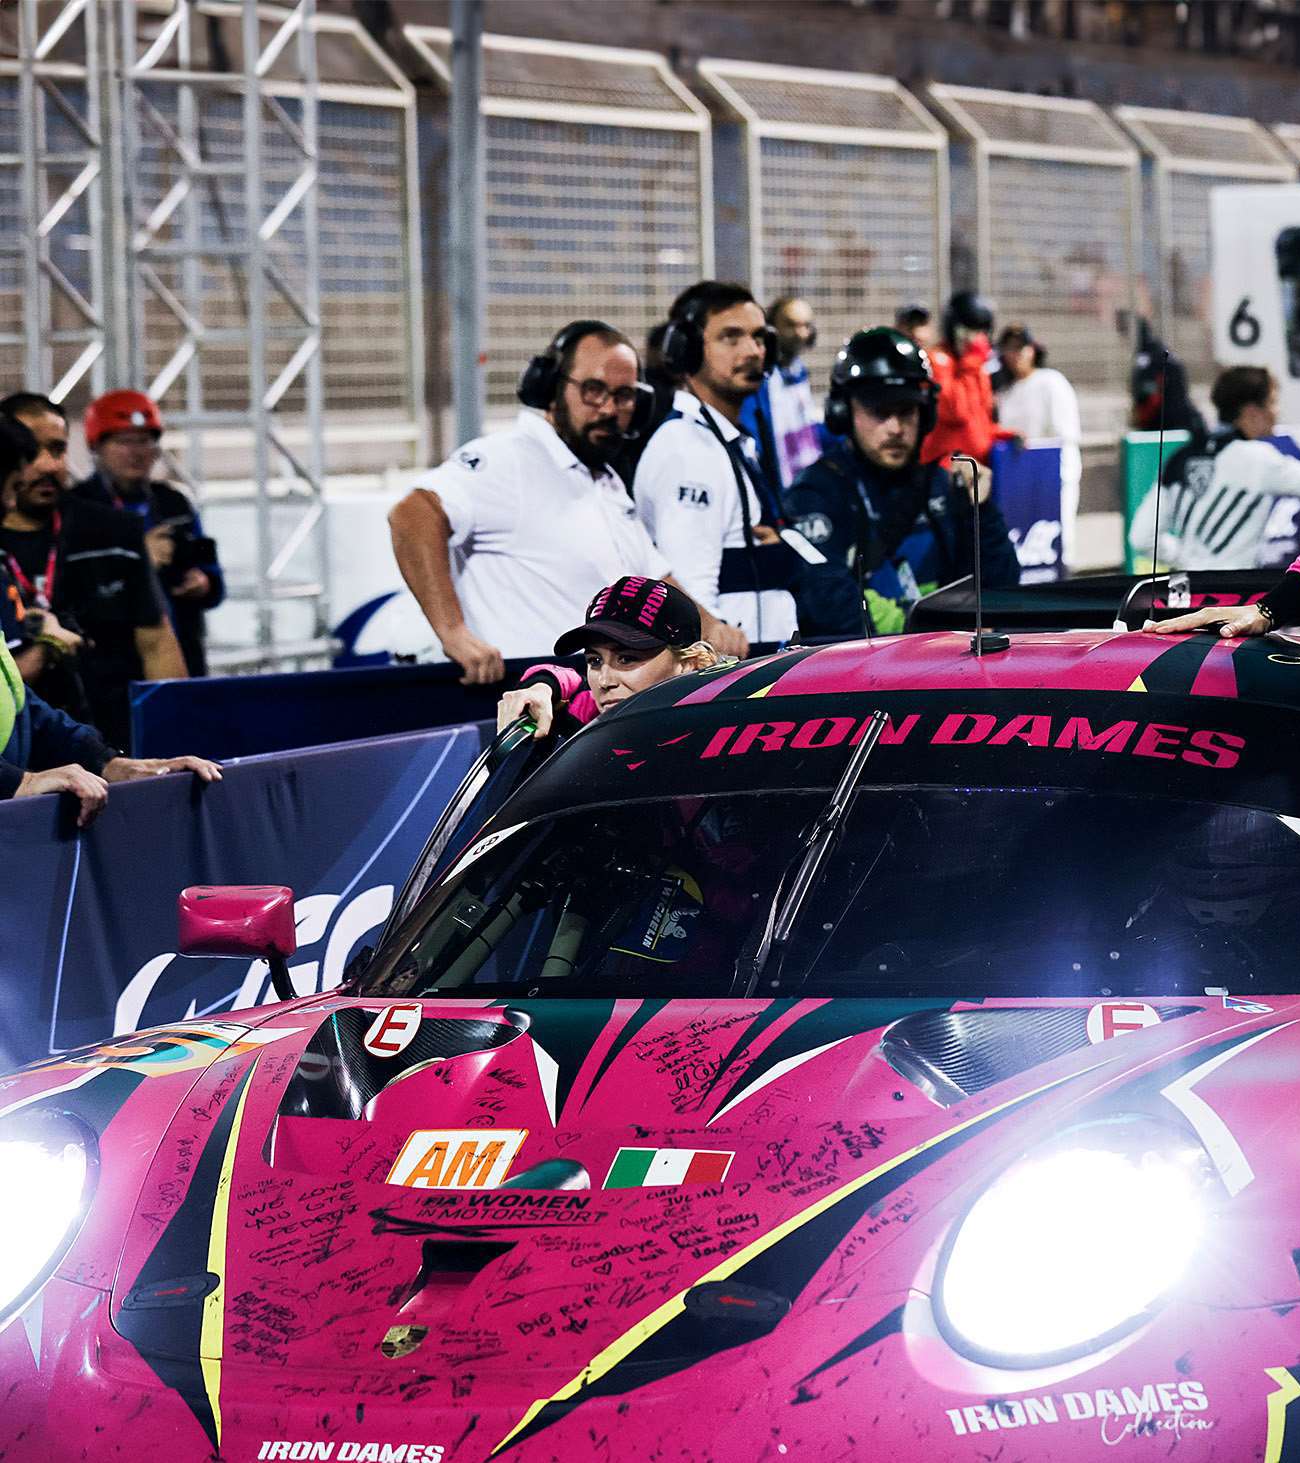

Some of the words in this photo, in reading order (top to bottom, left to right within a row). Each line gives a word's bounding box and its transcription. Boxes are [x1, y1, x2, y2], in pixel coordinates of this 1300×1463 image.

[1229, 298, 1260, 347] 6
[678, 486, 709, 506] FIA
[699, 714, 921, 759] IRON
[930, 713, 1246, 769] DAMES
[368, 1005, 419, 1051] E
[402, 1140, 507, 1188] AM
[416, 1208, 437, 1218] IN
[437, 1207, 609, 1223] MOTORSPORT
[468, 1193, 592, 1210] WOMEN
[570, 1239, 657, 1268] Goodbye
[945, 1394, 1060, 1436] IRON
[1062, 1381, 1209, 1422] DAMES
[257, 1441, 336, 1461] IRON
[336, 1442, 446, 1463] DAMES
